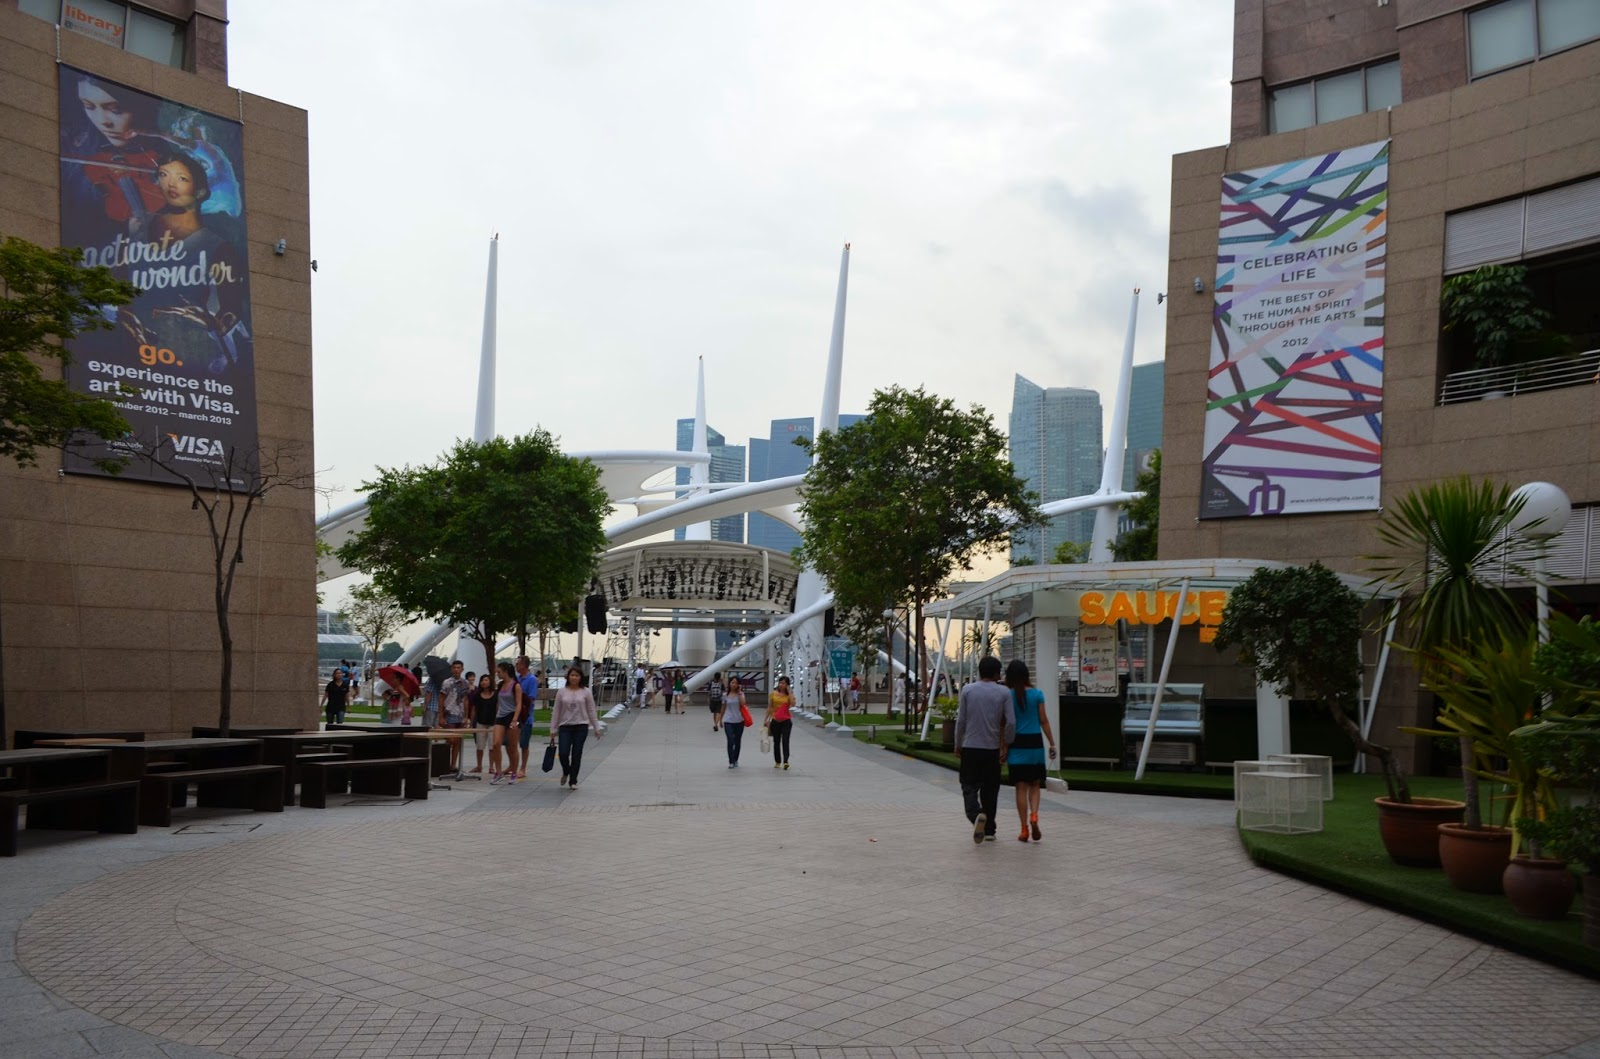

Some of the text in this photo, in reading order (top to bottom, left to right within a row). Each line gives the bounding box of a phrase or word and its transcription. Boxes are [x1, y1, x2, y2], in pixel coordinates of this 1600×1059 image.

[65, 4, 124, 37] library
[82, 229, 188, 268] activate
[1243, 241, 1358, 270] CELEBRATING
[1281, 268, 1316, 283] LIFE
[1260, 288, 1335, 307] THE BEST OF
[1238, 310, 1357, 334] THROUGH THE ARTS
[1242, 298, 1352, 322] THE HUMAN SPIRIT
[139, 343, 183, 366] go.
[1281, 337, 1308, 348] 2012
[88, 360, 234, 396] experience the
[140, 387, 185, 407] with
[189, 393, 240, 415] Visa.
[145, 404, 169, 416] 2012
[178, 411, 208, 422] march
[210, 414, 232, 425] 2013
[167, 432, 224, 456] VISA
[1079, 590, 1226, 625] SAUCE
